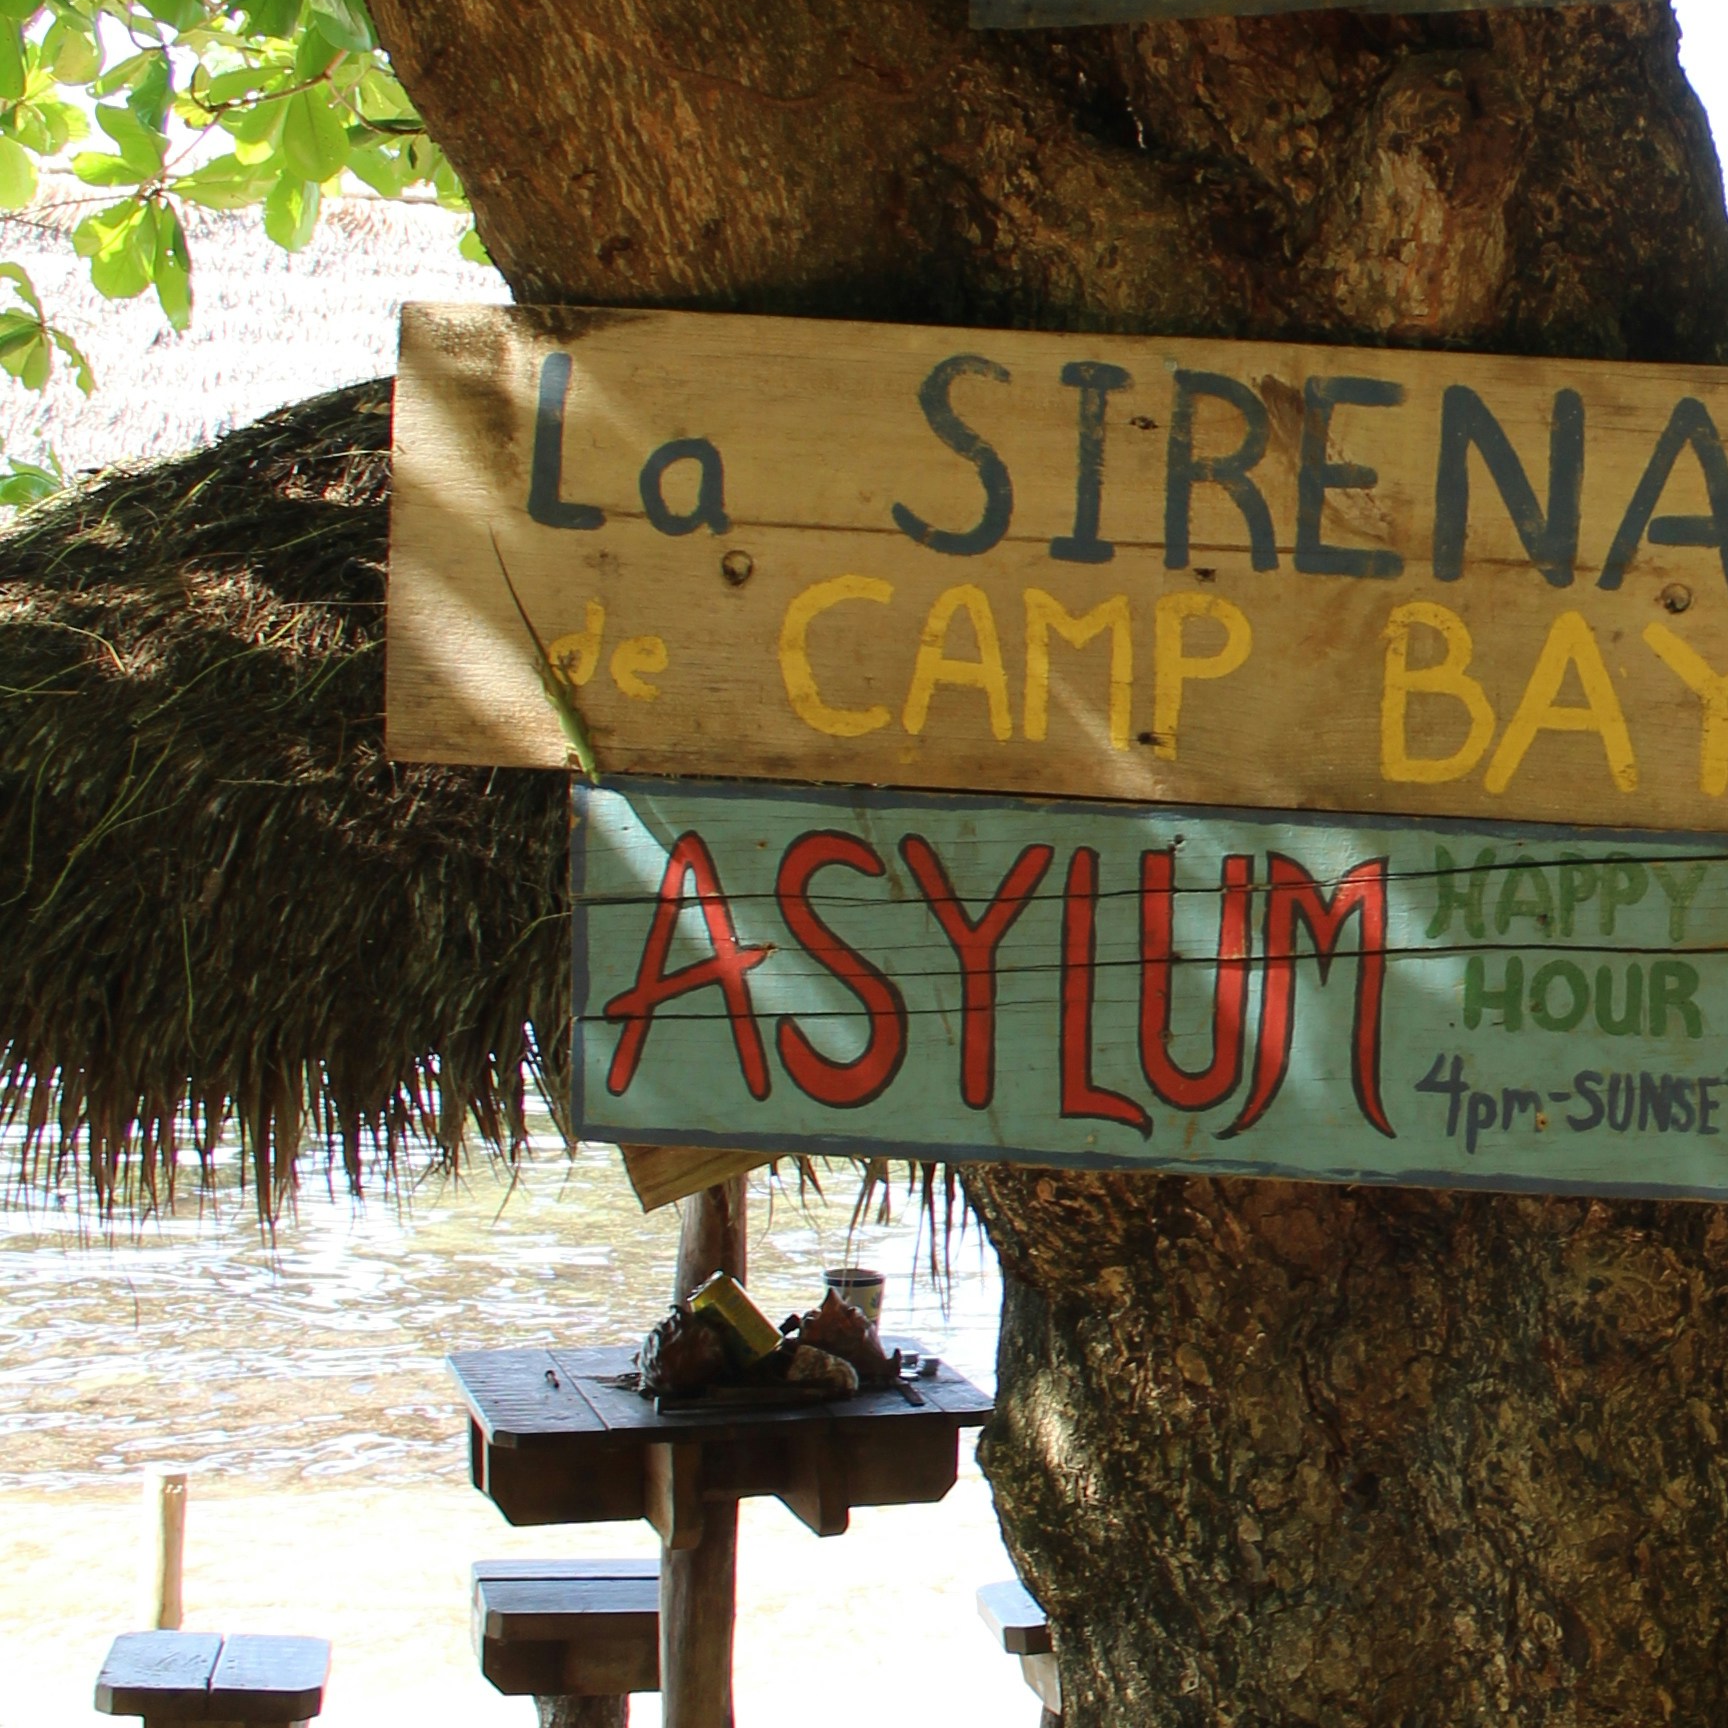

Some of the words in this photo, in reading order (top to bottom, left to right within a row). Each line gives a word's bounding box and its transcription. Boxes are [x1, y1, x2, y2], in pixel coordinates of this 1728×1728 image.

[527, 351, 732, 538] La
[548, 599, 670, 702] de
[777, 573, 1254, 761] CAMP
[602, 828, 1398, 1141] ASYLUM
[1425, 843, 1709, 943] HAPPY
[1462, 954, 1704, 1039] HOUR
